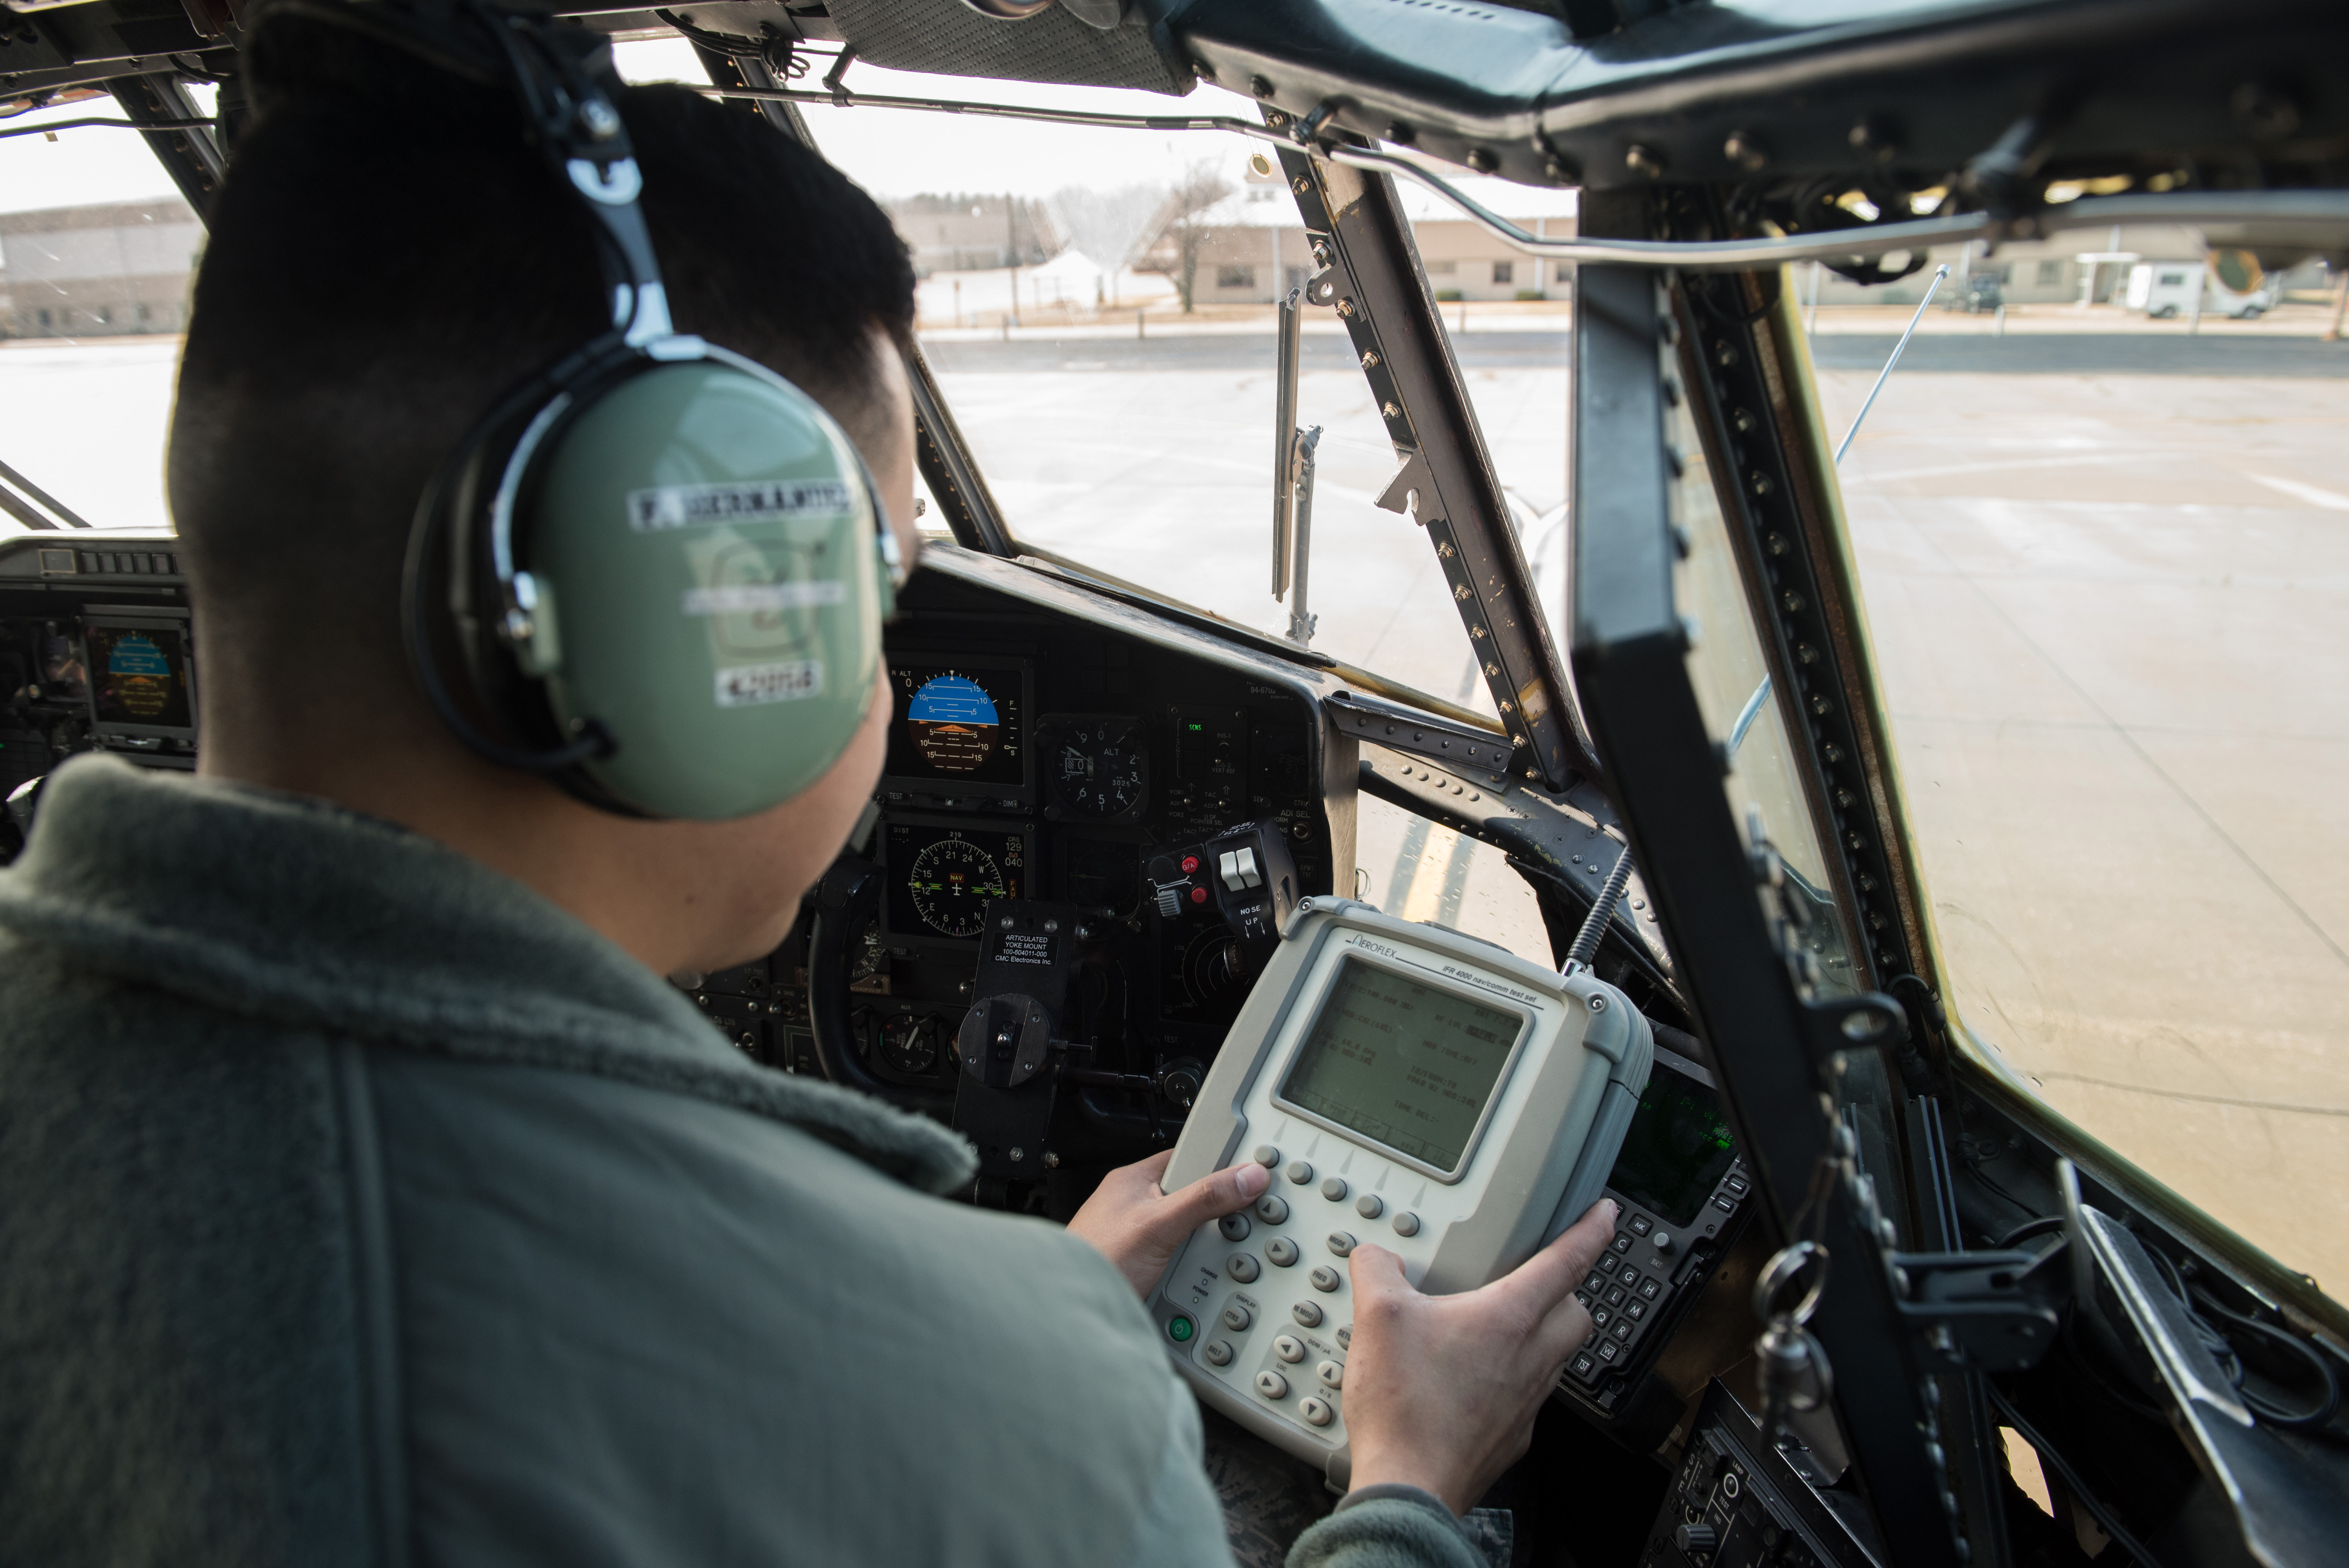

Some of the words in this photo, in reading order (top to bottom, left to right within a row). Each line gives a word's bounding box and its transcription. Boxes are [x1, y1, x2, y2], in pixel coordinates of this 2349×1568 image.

[1080, 733, 1087, 743] 9
[1098, 730, 1104, 740] 0
[1130, 754, 1136, 764] 2
[1078, 761, 1084, 770] 0
[1131, 772, 1137, 782] 3
[1080, 788, 1086, 797] 6
[1117, 790, 1124, 800] 4
[1099, 795, 1105, 804] 5
[1006, 843, 1021, 851] 129
[1005, 857, 1022, 867] 040
[1240, 905, 1261, 915] NOSE
[1005, 935, 1048, 943] ARTICULATED
[893, 947, 906, 956] TEST
[1352, 934, 1397, 959] AEROFLEX
[1003, 949, 1047, 957] 100-604011-000
[1442, 966, 1455, 975] IFR
[1456, 970, 1473, 980] 4000
[1472, 975, 1508, 993] nav/comm
[1510, 987, 1524, 998] test
[1524, 992, 1538, 1003] set
[1634, 1222, 1645, 1231] MK
[1329, 1235, 1346, 1248] MODE
[1618, 1240, 1626, 1249] C
[1651, 1257, 1663, 1269] BRT
[1201, 1267, 1218, 1279] CHARGE
[1313, 1270, 1327, 1283] FREQ
[1625, 1272, 1633, 1281] G
[1591, 1279, 1599, 1288] K
[1192, 1285, 1208, 1297] POWER
[1645, 1285, 1655, 1295] H
[1236, 1294, 1256, 1308] DISPLAY
[1612, 1292, 1617, 1301] L
[1299, 1308, 1313, 1319] MOD
[1630, 1305, 1641, 1316] M
[1225, 1310, 1239, 1322] CTRS
[1597, 1313, 1606, 1323] Q
[1338, 1329, 1351, 1341] SETU
[1618, 1326, 1625, 1336] R
[1308, 1339, 1320, 1348] DDM
[1208, 1345, 1222, 1357] BKLT
[1604, 1345, 1613, 1356] W
[1276, 1363, 1287, 1372] LOC
[1578, 1359, 1590, 1372] TST
[1732, 1460, 1744, 1475] LAMP
[1719, 1495, 1730, 1510] TEST
